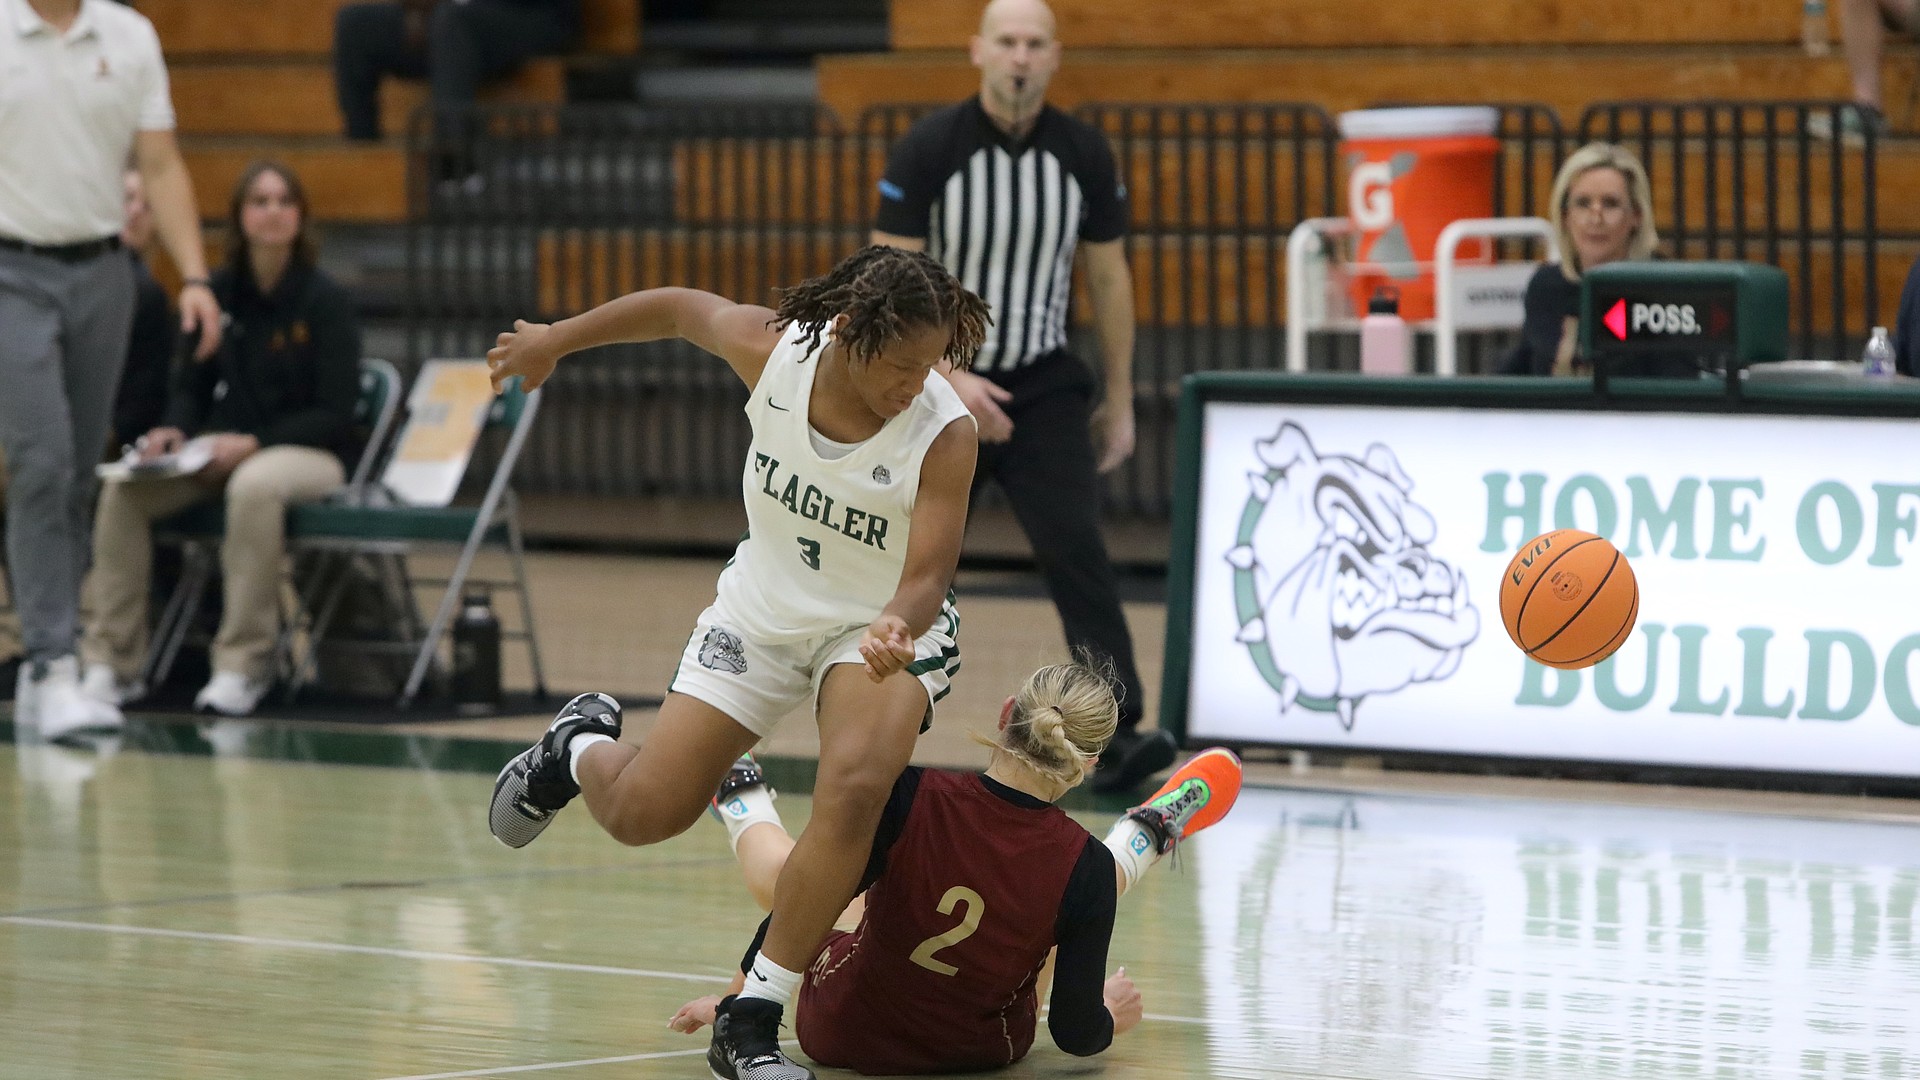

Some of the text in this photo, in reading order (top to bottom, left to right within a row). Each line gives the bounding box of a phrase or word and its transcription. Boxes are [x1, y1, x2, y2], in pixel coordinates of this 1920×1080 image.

[1349, 162, 1394, 231] G
[1631, 303, 1702, 335] POSS.
[754, 451, 889, 551] FLAGLER
[1478, 472, 1920, 567] HOME OF
[796, 536, 821, 571] 3
[1511, 538, 1551, 587] EVO
[909, 885, 986, 977] 2
